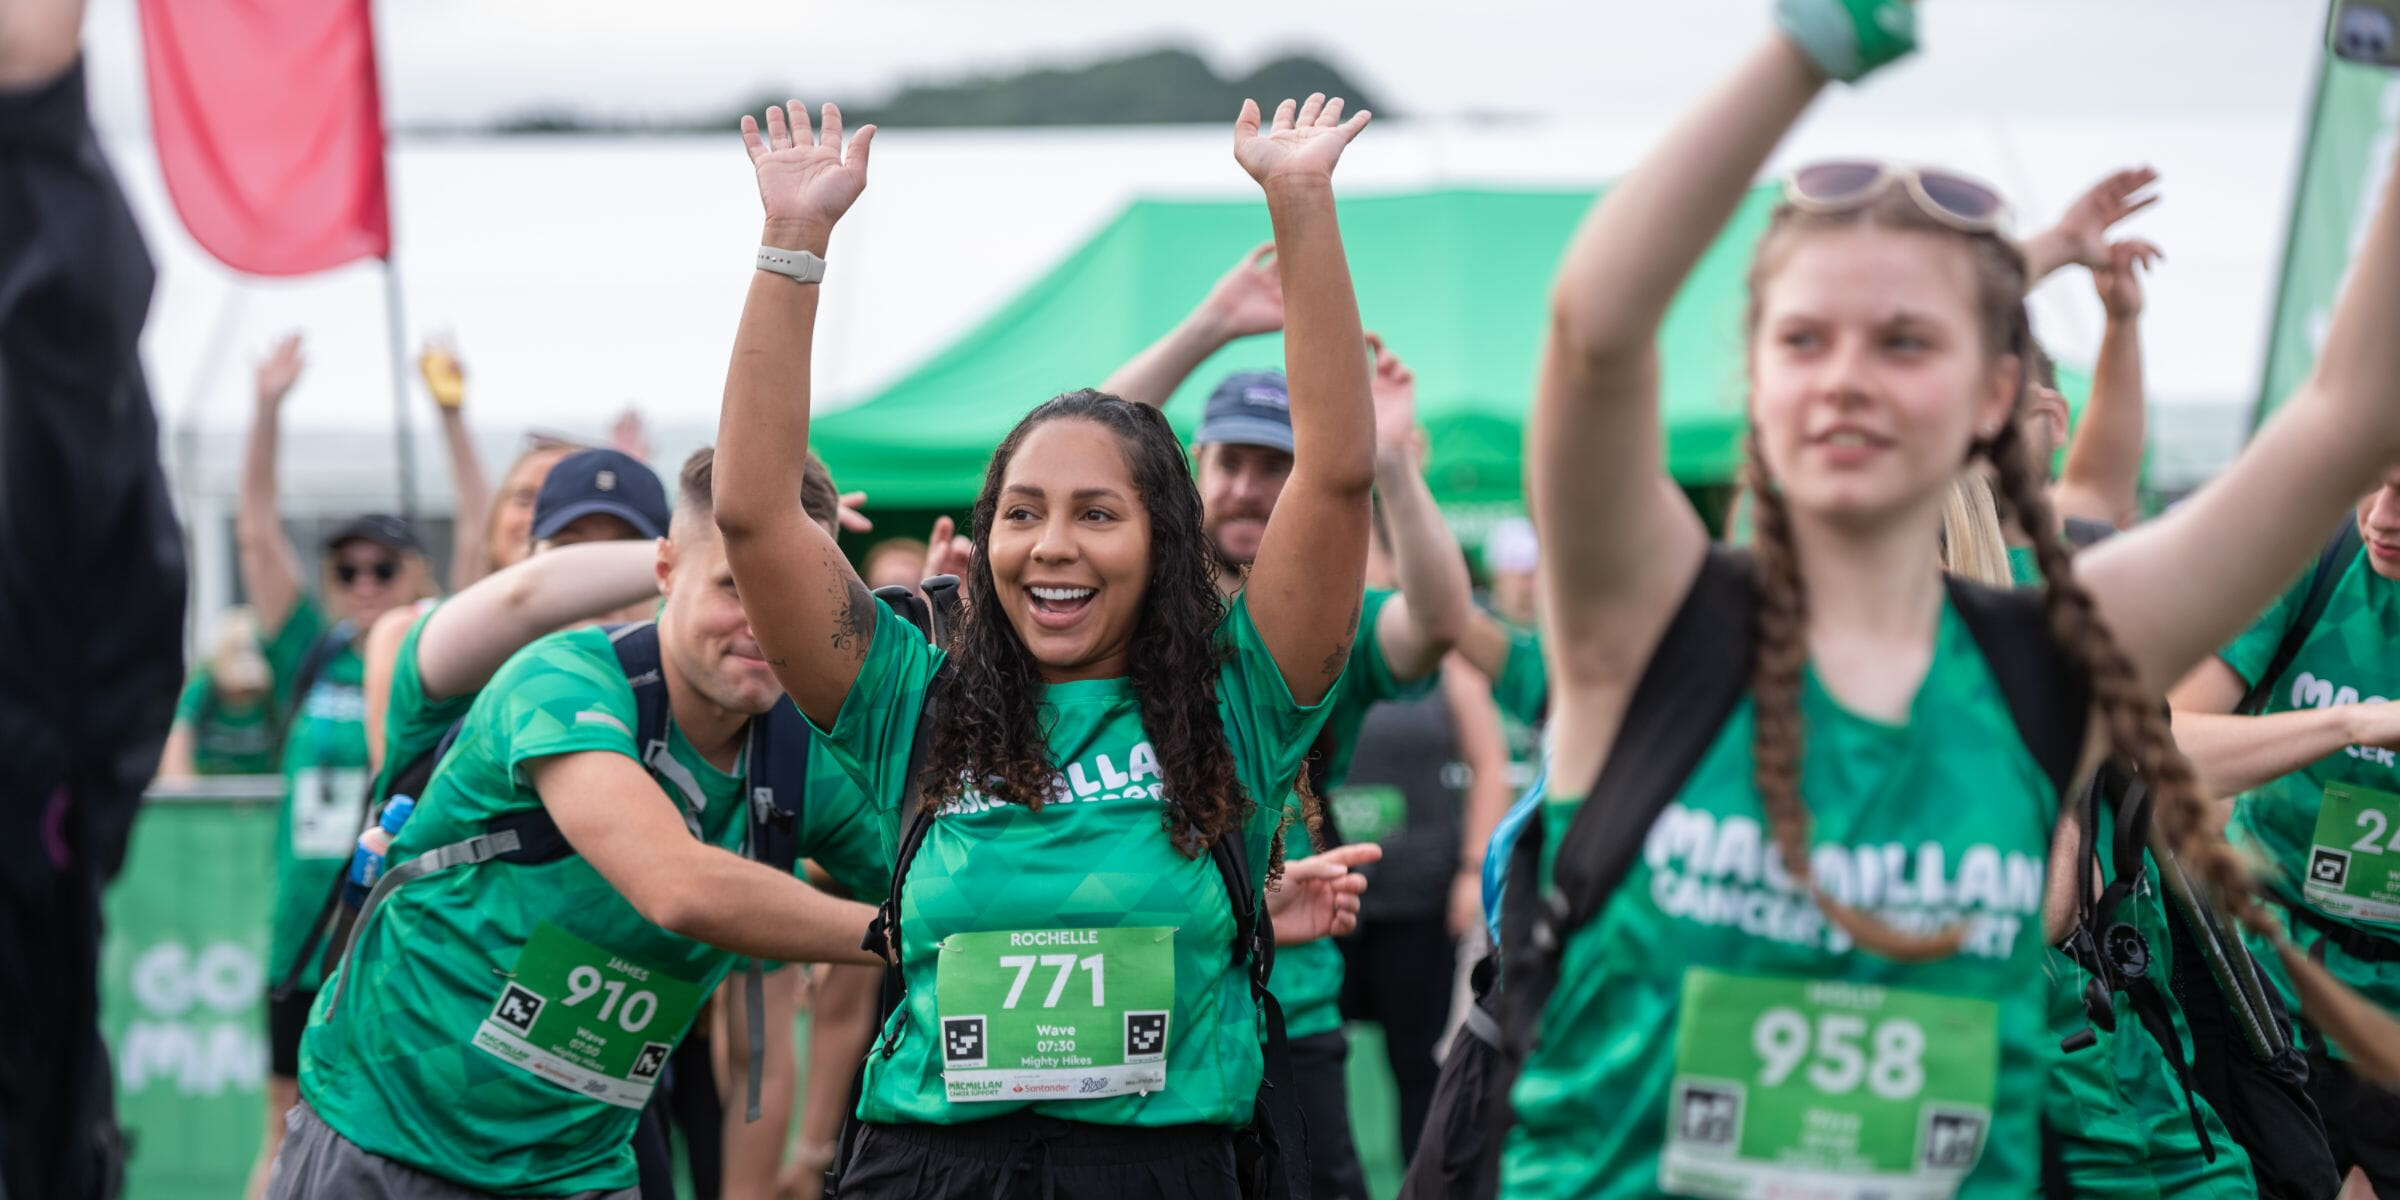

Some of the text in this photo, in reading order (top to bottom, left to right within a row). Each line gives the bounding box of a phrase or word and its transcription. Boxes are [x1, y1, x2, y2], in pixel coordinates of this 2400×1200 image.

[1010, 930, 1099, 947] ROCHELLE
[606, 956, 651, 982] JAMES
[1000, 953, 1105, 1010] 771
[560, 965, 658, 1033] 910
[1036, 1025, 1076, 1036] Wave
[1037, 1040, 1075, 1053] 07:30
[1754, 1007, 1926, 1100] 958
[1021, 1055, 1092, 1068] Mighty Hikes
[948, 1081, 1003, 1090] MACMILLAN
[1024, 1083, 1069, 1093] Santander
